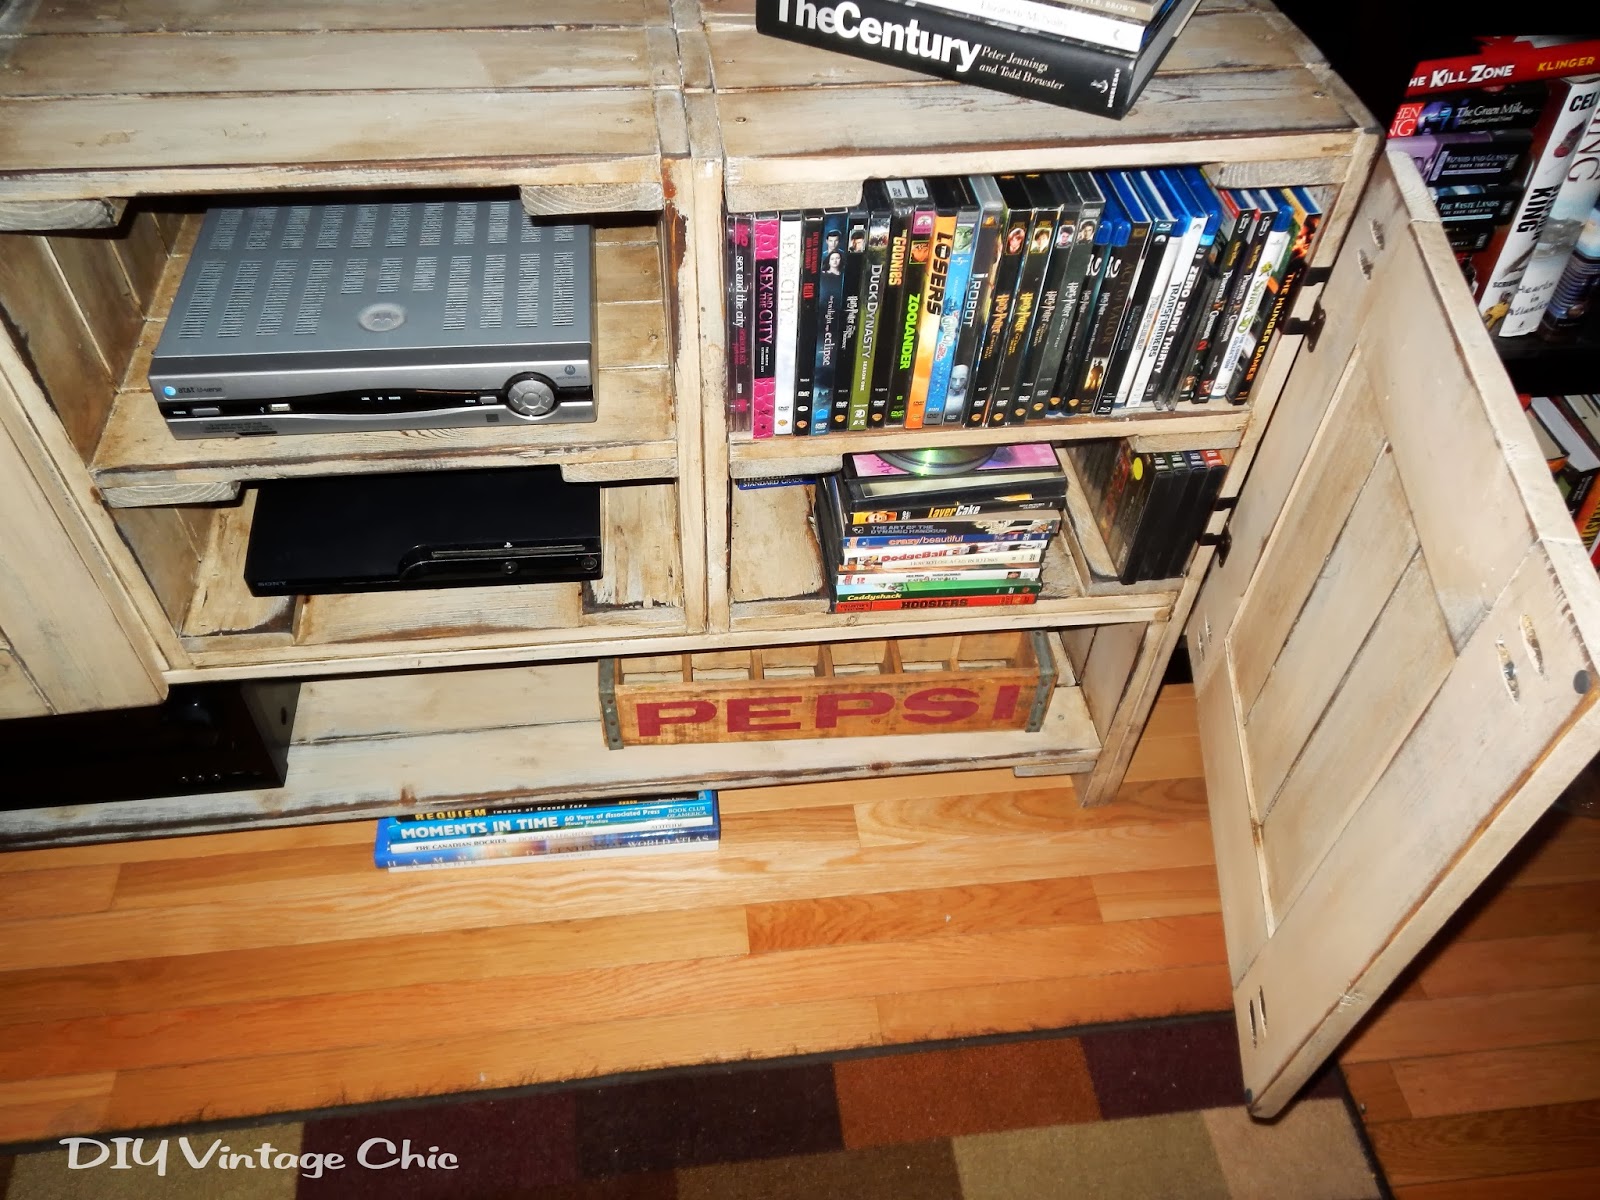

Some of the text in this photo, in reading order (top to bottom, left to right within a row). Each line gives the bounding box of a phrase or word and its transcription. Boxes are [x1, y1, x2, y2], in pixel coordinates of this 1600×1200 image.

[981, 45, 1049, 74] Peter Jennings
[1408, 56, 1595, 88] HE KILL ZONE KLINGER
[979, 63, 1065, 91] and Todd Brewster
[1107, 68, 1121, 108] DOUBLEDAY
[1456, 107, 1472, 118] The
[1473, 105, 1501, 116] Green
[1501, 102, 1524, 114] Mile
[1440, 202, 1452, 211] THE
[1476, 200, 1500, 208] LANDS
[1516, 187, 1553, 233] KING
[760, 266, 774, 291] SEX
[868, 264, 882, 301] DUCK
[926, 232, 954, 316] LOSERS
[1181, 265, 1200, 298] ZERO
[732, 255, 749, 328] sex and the city
[759, 292, 767, 308] THE
[963, 280, 982, 328] ROBOT
[759, 309, 773, 344] CITY
[862, 302, 878, 358] DYNASTY
[900, 293, 921, 370] ZOOLANDER
[1149, 282, 1183, 358] TRANSFORMERS
[1168, 301, 1186, 333] DARK
[1245, 271, 1297, 381] THE HUNGER GAMES
[819, 332, 835, 366] eclipse
[1154, 335, 1175, 374] THIRTY
[742, 480, 780, 488] STANDARD
[928, 504, 981, 519] Layer Cake
[888, 535, 964, 547] crazy/beautiful
[847, 592, 902, 600] Caddyshack
[900, 598, 969, 609] HOOSIERS
[636, 684, 1021, 737] PEPSI
[400, 822, 488, 840] MOMENTS
[492, 820, 511, 832] IN
[516, 816, 558, 830] TIME
[577, 813, 595, 821] Years
[605, 810, 641, 819] Associated
[415, 808, 487, 821] REQUIEM
[432, 842, 473, 850] CANADIAN
[473, 838, 507, 846] ROCKIES
[627, 835, 710, 847] WORLD ATLAS
